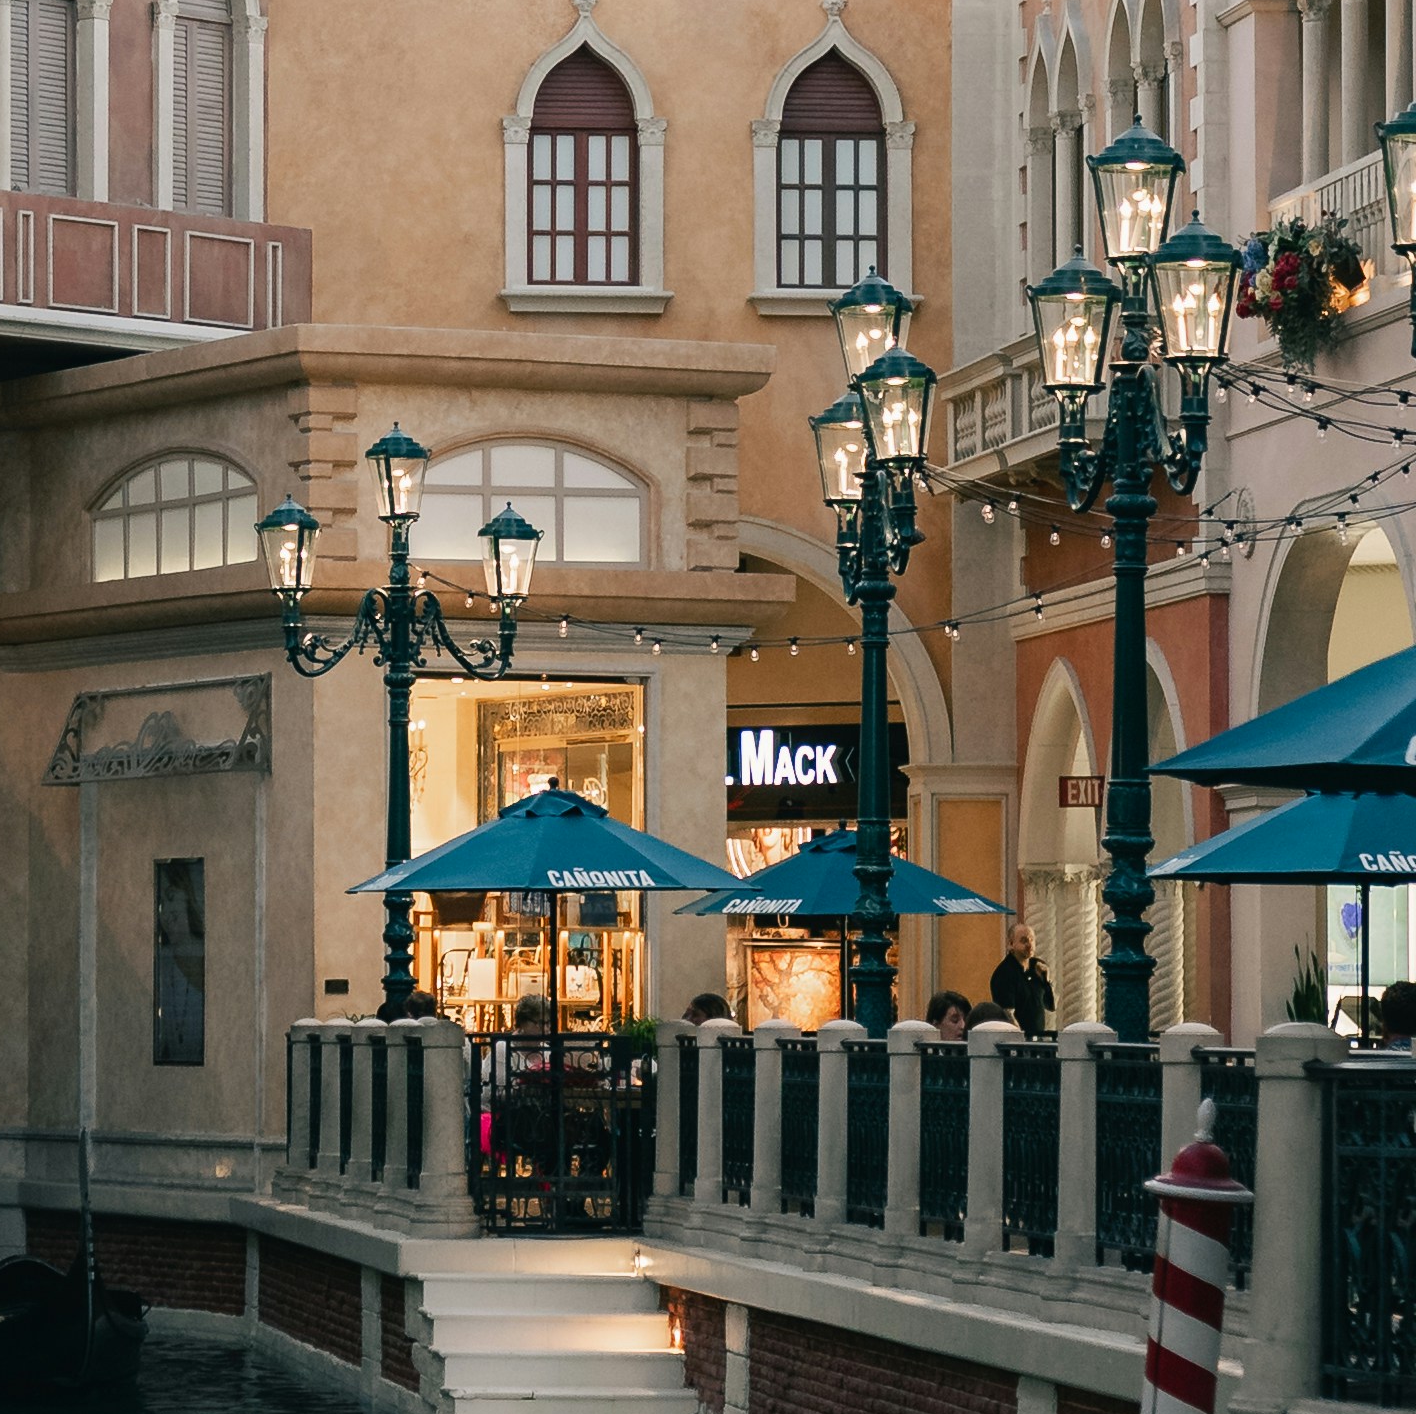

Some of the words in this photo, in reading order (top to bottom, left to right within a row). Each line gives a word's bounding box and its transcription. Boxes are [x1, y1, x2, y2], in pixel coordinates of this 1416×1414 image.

[1067, 779, 1101, 805] EXIT
[546, 867, 657, 887] CAÑONITA
[721, 896, 803, 914] CAÑONITA
